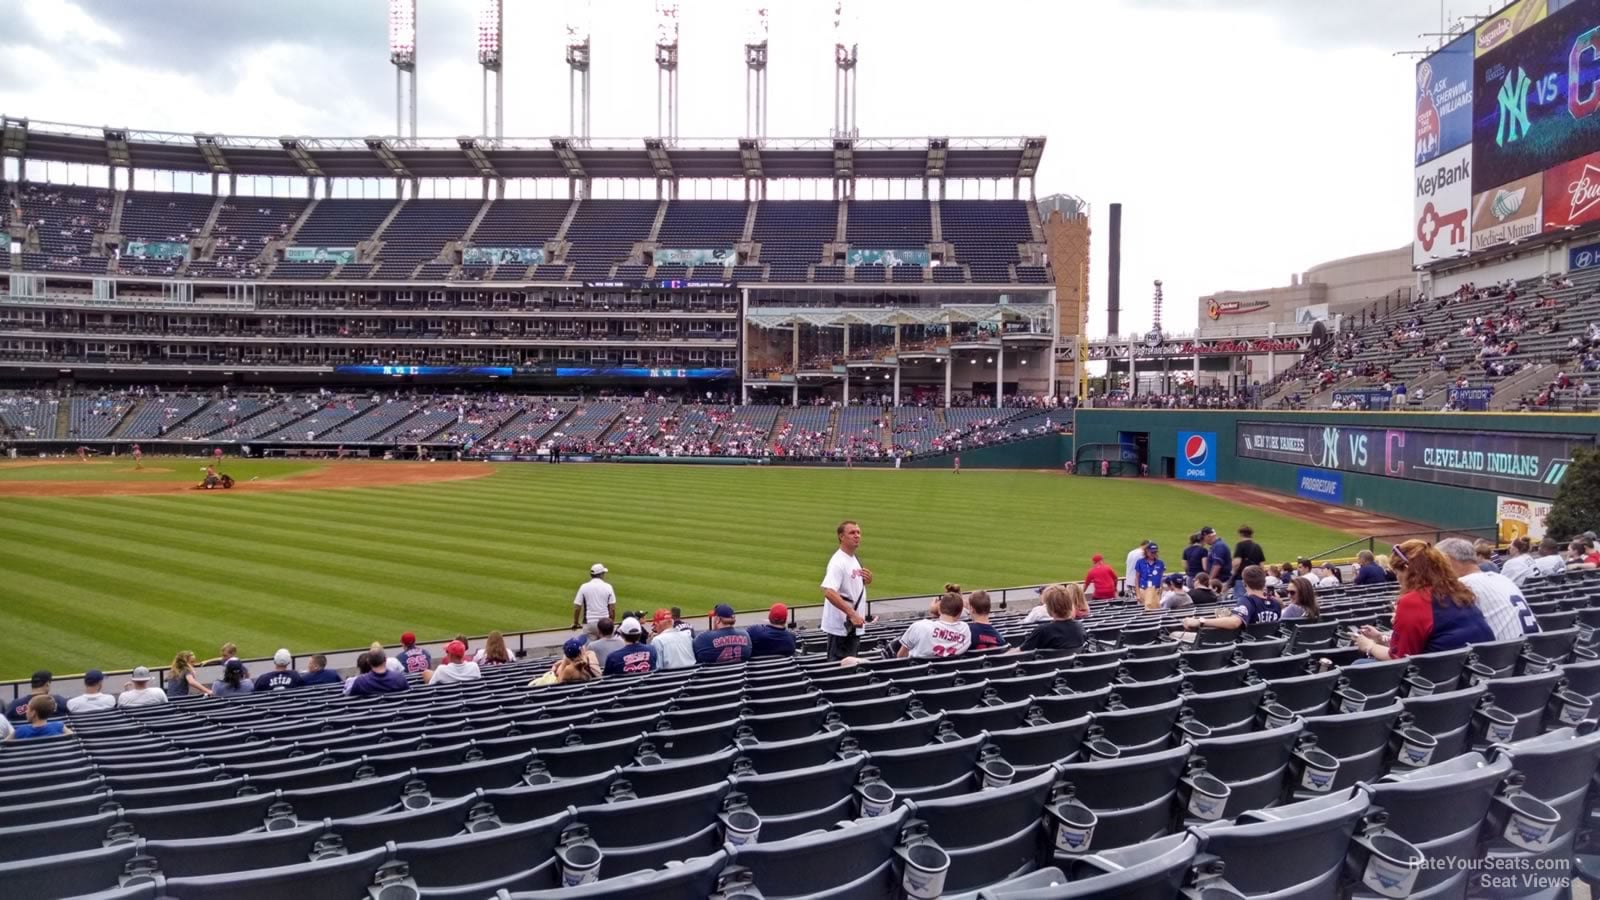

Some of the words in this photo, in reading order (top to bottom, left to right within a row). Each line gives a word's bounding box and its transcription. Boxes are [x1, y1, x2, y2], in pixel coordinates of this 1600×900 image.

[1433, 77, 1447, 95] ASK
[1435, 79, 1468, 107] SHERWIN
[1536, 72, 1559, 106] VS
[1439, 90, 1473, 118] WILLIAMS
[1416, 157, 1470, 198] KeyBank
[1475, 227, 1506, 248] Medical
[1508, 217, 1537, 240] Mutual
[1280, 437, 1305, 452] YANKEES
[1349, 434, 1368, 466] VS
[1385, 429, 1405, 477] C
[1424, 447, 1484, 472] CLEVELAND
[1487, 452, 1539, 477] INDIANS
[1187, 468, 1205, 478] pepsi
[1257, 611, 1278, 624] JETER
[713, 634, 749, 649] SANTANA
[933, 626, 966, 644] SWISHER
[407, 654, 429, 672] 25
[717, 645, 742, 663] 41
[269, 674, 293, 688] JETER
